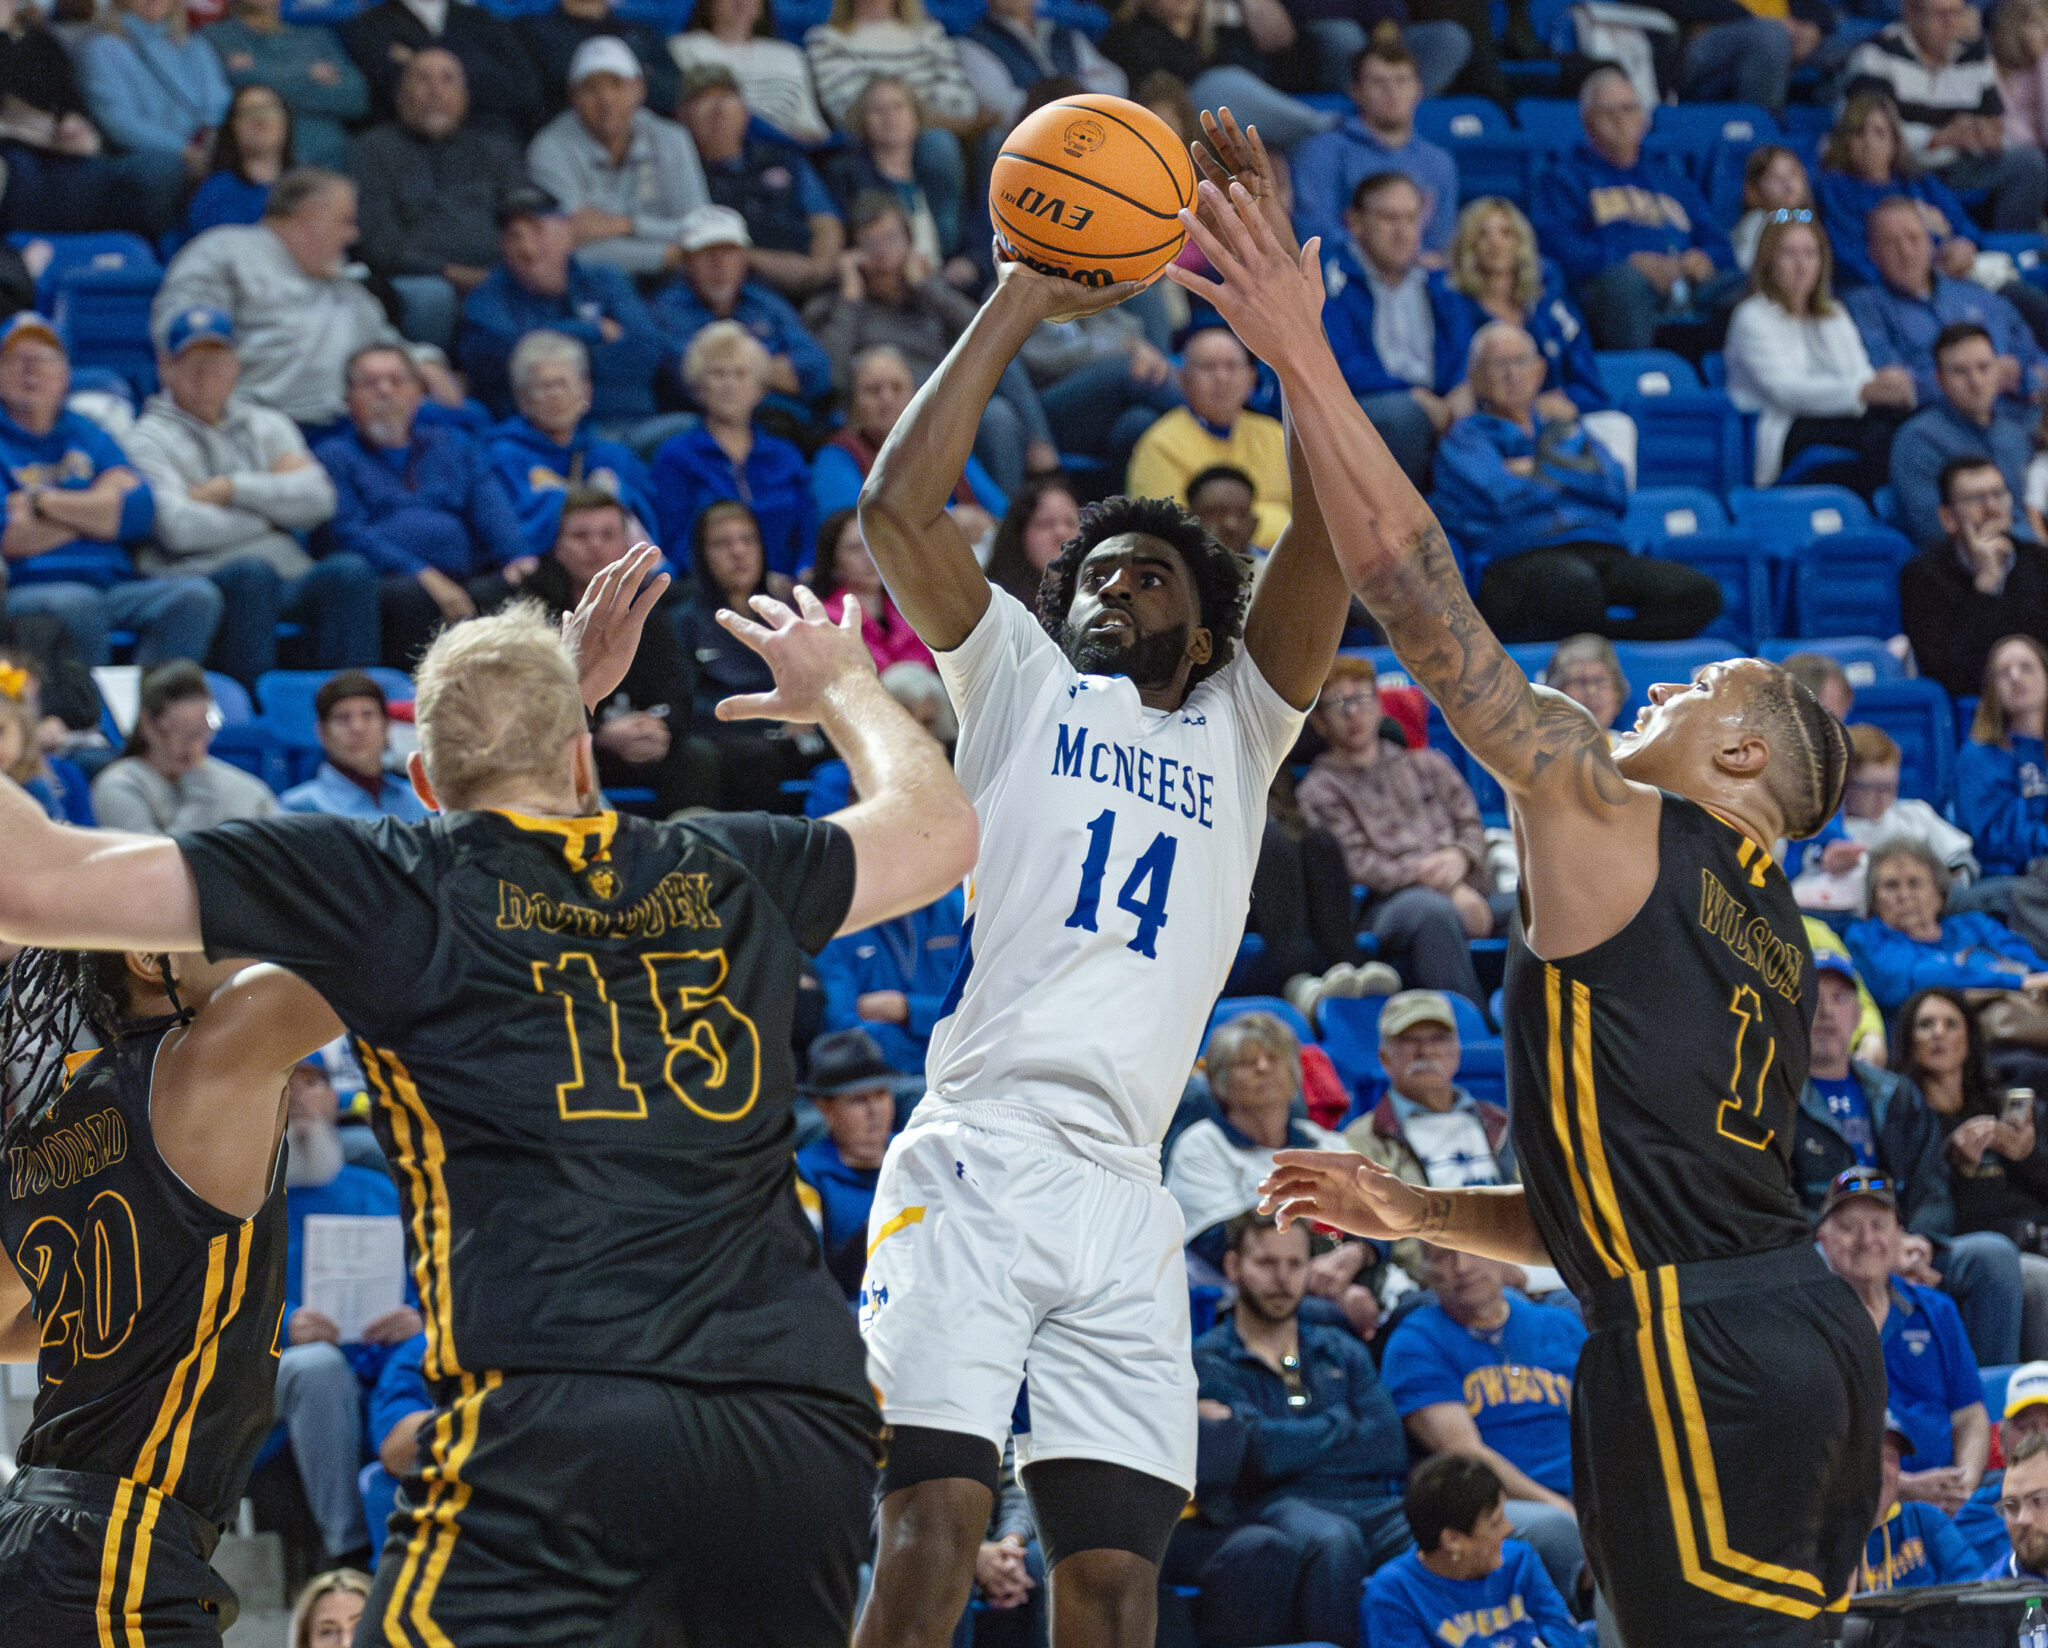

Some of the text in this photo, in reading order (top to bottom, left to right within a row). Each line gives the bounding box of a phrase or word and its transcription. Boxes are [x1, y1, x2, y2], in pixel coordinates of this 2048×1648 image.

[1015, 186, 1095, 232] EVO
[1064, 808, 1179, 961] 14
[1700, 867, 1804, 1005] WILSON
[530, 947, 761, 1122] 15
[1708, 983, 1776, 1151] 1
[9, 1106, 128, 1201] WOODARD
[16, 1188, 142, 1386] 20
